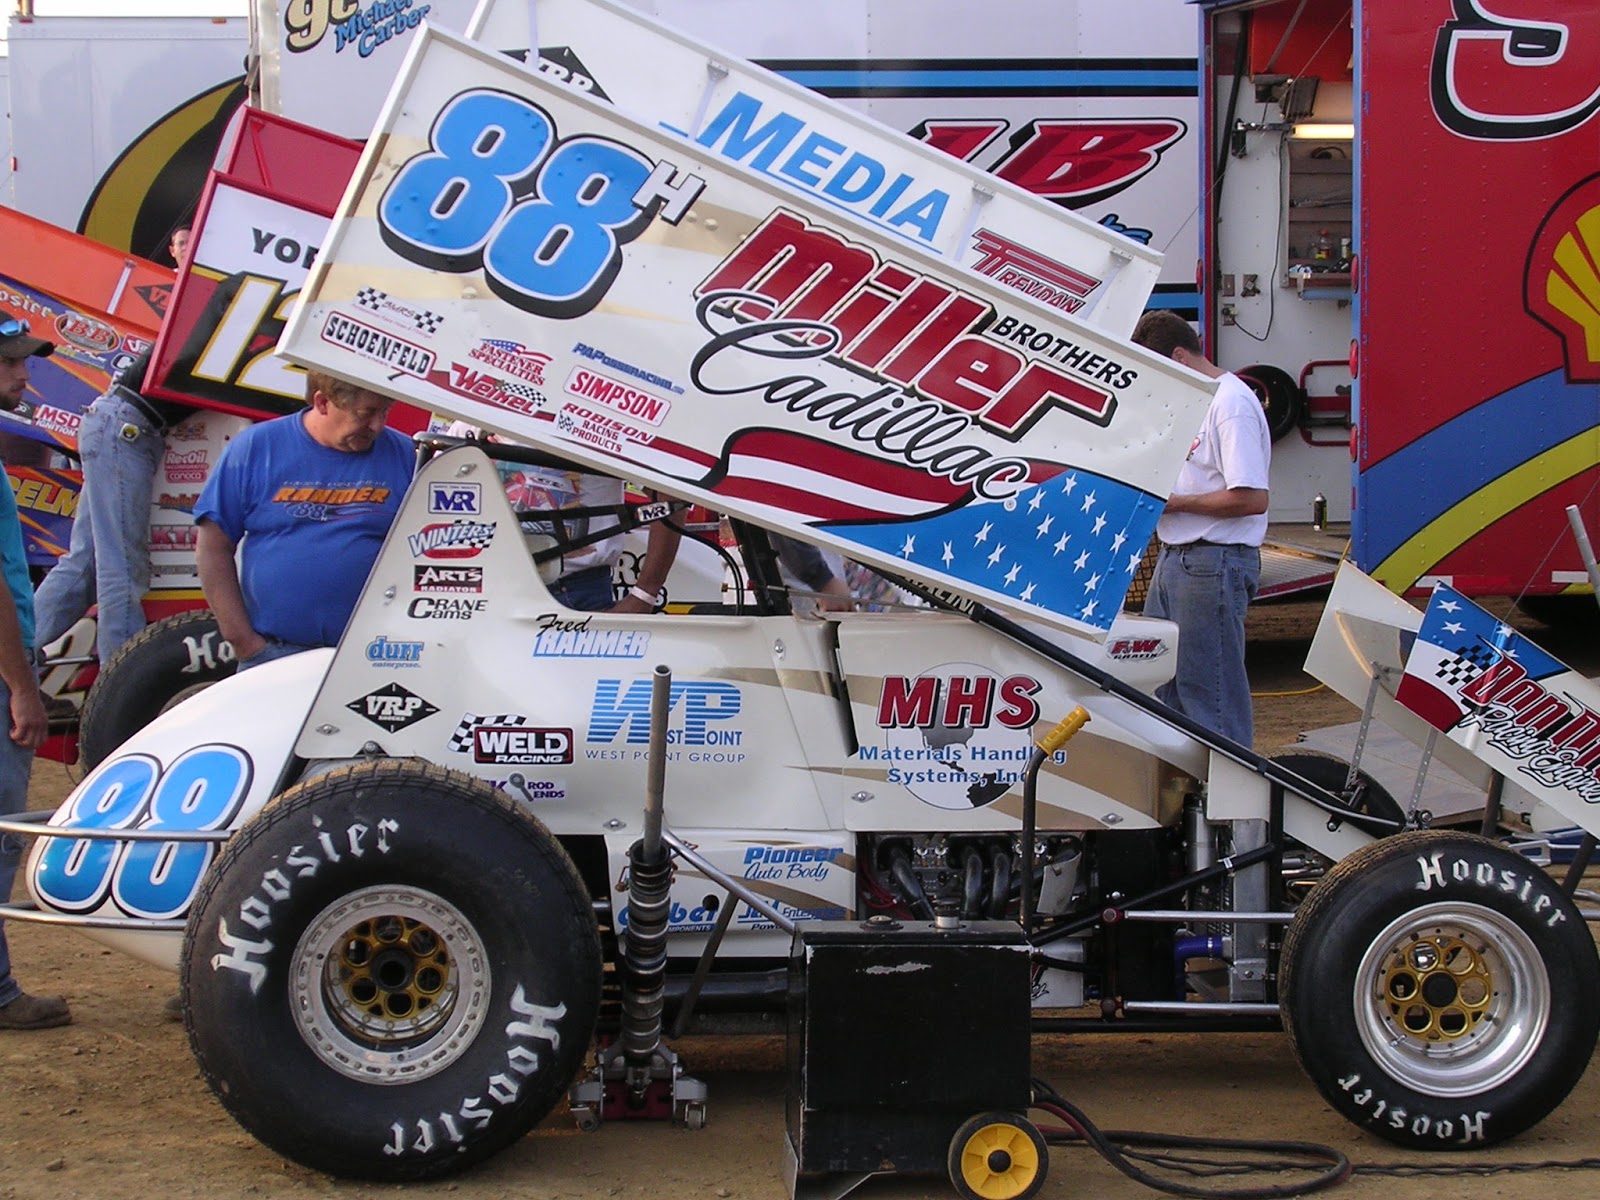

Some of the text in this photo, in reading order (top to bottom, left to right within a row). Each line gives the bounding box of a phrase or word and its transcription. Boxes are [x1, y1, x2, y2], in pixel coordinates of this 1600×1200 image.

[695, 91, 951, 243] MEDIA
[325, 315, 431, 375] SCHOENFELD
[479, 341, 545, 376] FASTENER
[994, 314, 1139, 391] BROTHERS
[468, 347, 546, 387] SPECIALTIES
[570, 371, 664, 422] SIMPSON
[690, 288, 1031, 501] Cadillac
[41, 406, 82, 428] MSD
[562, 402, 653, 443] ROBISON
[581, 420, 619, 441] RACING
[571, 426, 623, 454] PRODUCTS
[407, 524, 494, 558] WINTERS
[419, 585, 477, 593] RADIATOR
[535, 613, 594, 637] Fred
[365, 635, 425, 662] durr
[533, 630, 652, 658] RAHMER
[365, 695, 423, 717] VRP
[876, 675, 1042, 729] MHS
[478, 731, 569, 755] WELD
[1457, 702, 1556, 760] Racing
[494, 754, 564, 763] RACING
[585, 749, 627, 760] WEST
[688, 752, 746, 763] GROUP
[858, 745, 1067, 764] Materials Handlg
[527, 781, 555, 790] ROD
[887, 767, 986, 786] Systems,
[533, 790, 566, 799] ENDS
[33, 742, 255, 919] 88
[743, 846, 845, 865] Pioneer
[743, 861, 830, 882] Auto Body
[1414, 852, 1567, 927] Hoosier
[210, 814, 400, 996] Hoosier
[382, 982, 568, 1157] Hoosier
